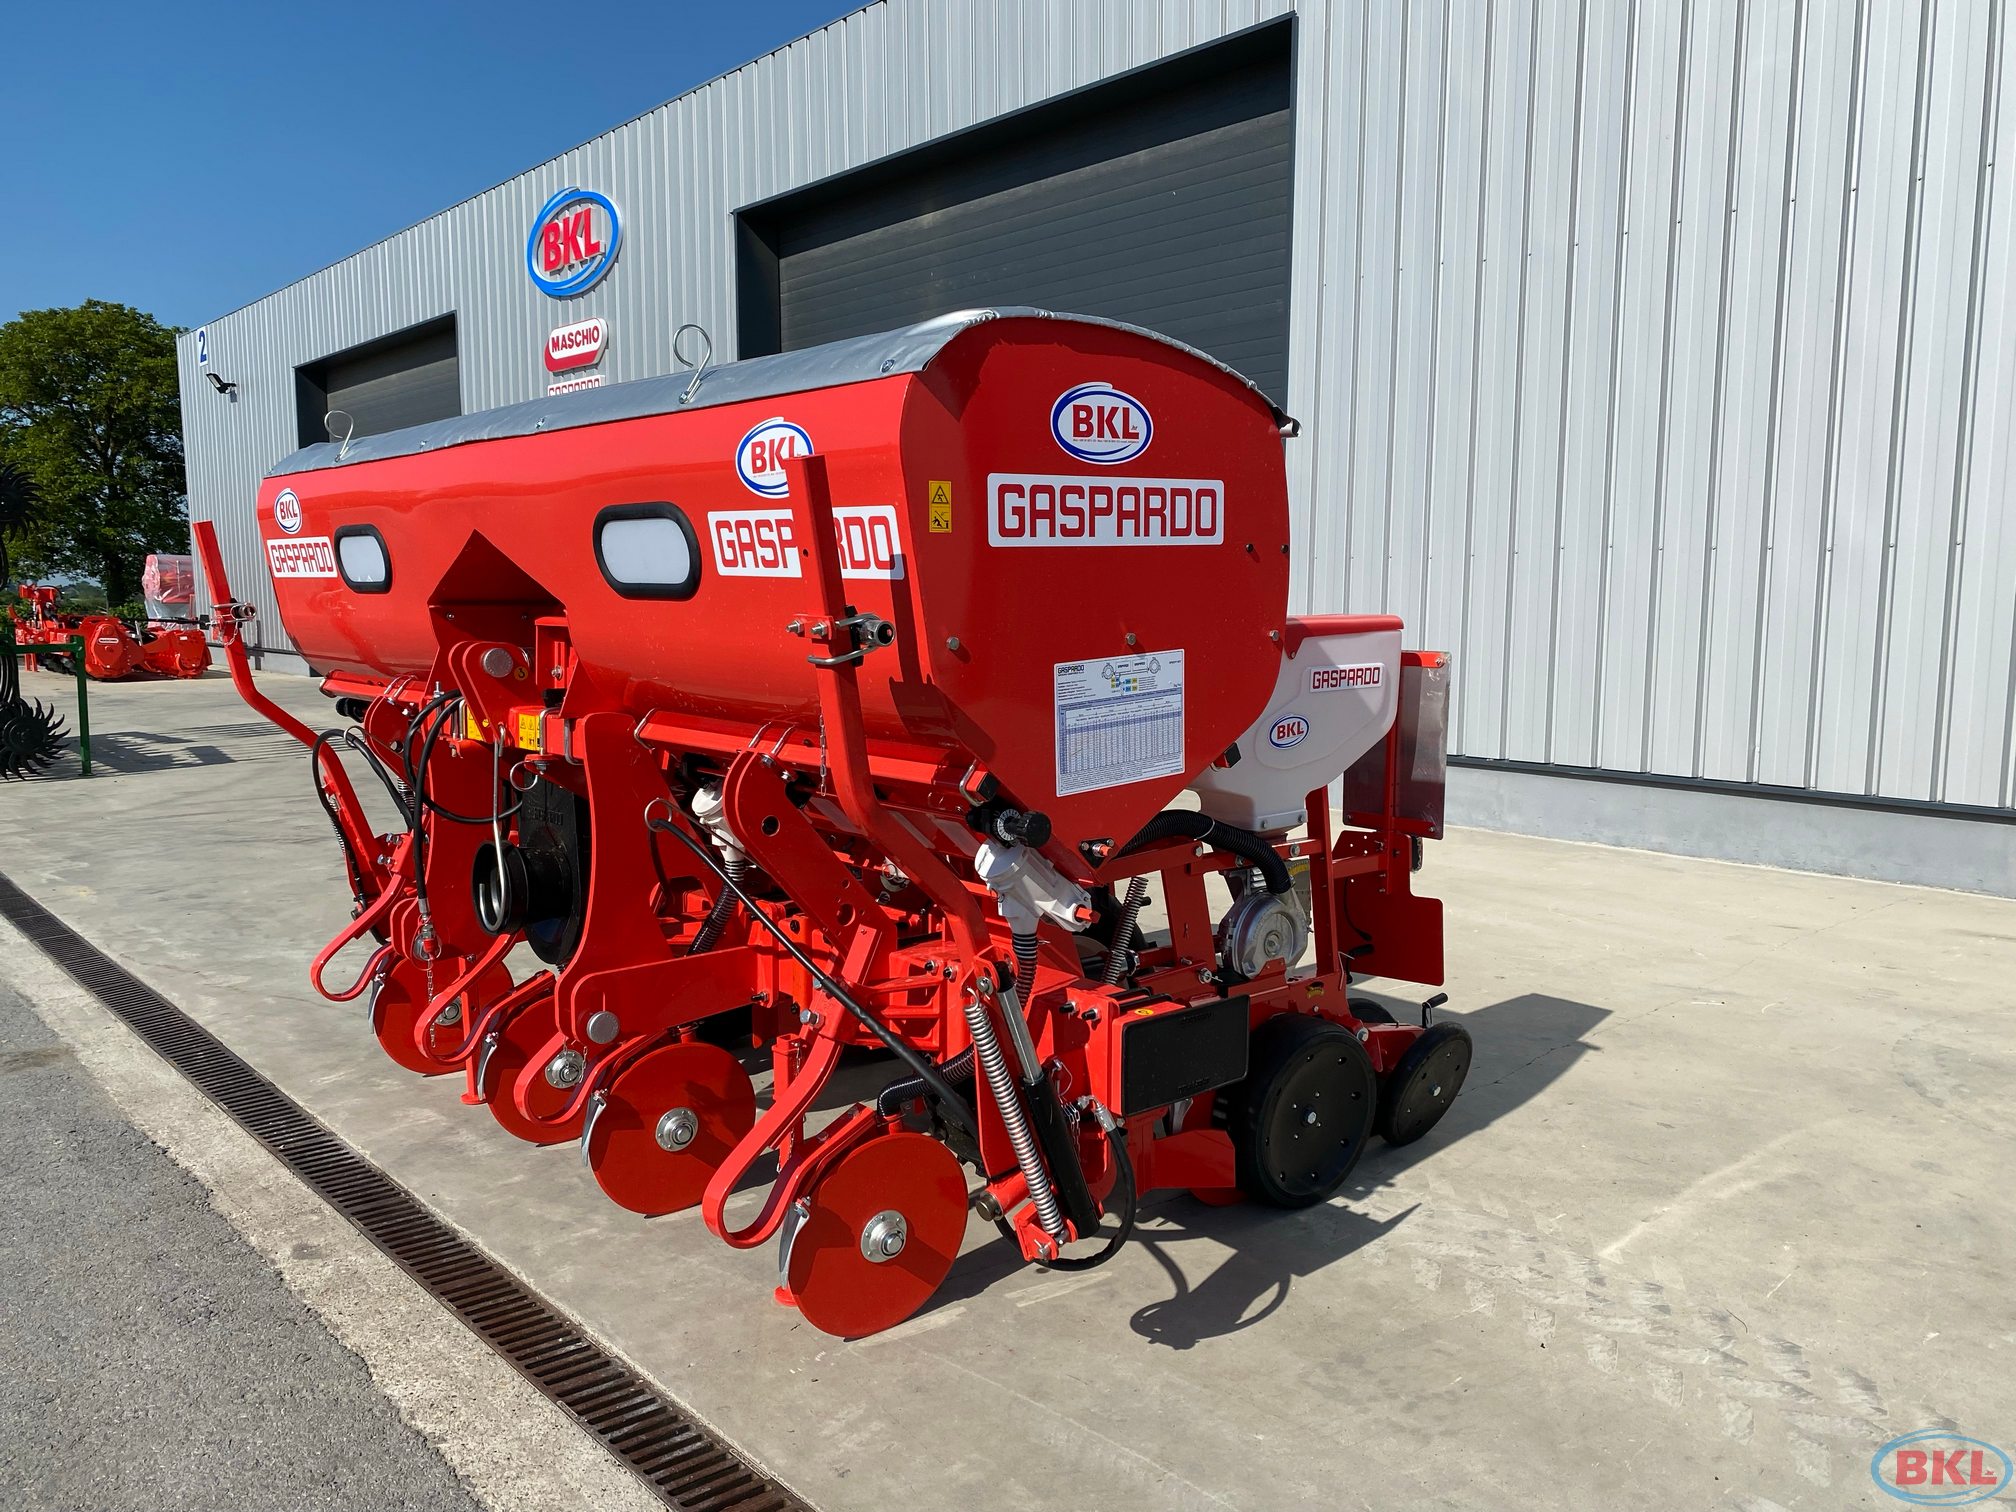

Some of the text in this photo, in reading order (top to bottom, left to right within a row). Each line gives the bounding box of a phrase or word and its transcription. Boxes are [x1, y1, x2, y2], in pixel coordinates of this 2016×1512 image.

[542, 208, 601, 272] BKL
[198, 330, 207, 363] 2
[551, 325, 600, 353] MASCHIO
[1072, 404, 1140, 440] BKL
[279, 499, 298, 520] BKL
[996, 483, 1217, 538] GASPARDO
[270, 542, 334, 573] GASPARDO
[715, 515, 897, 570] GASPDO
[517, 668, 526, 679] 3
[1312, 667, 1381, 690] GASPARDO
[1276, 721, 1305, 740] BKL
